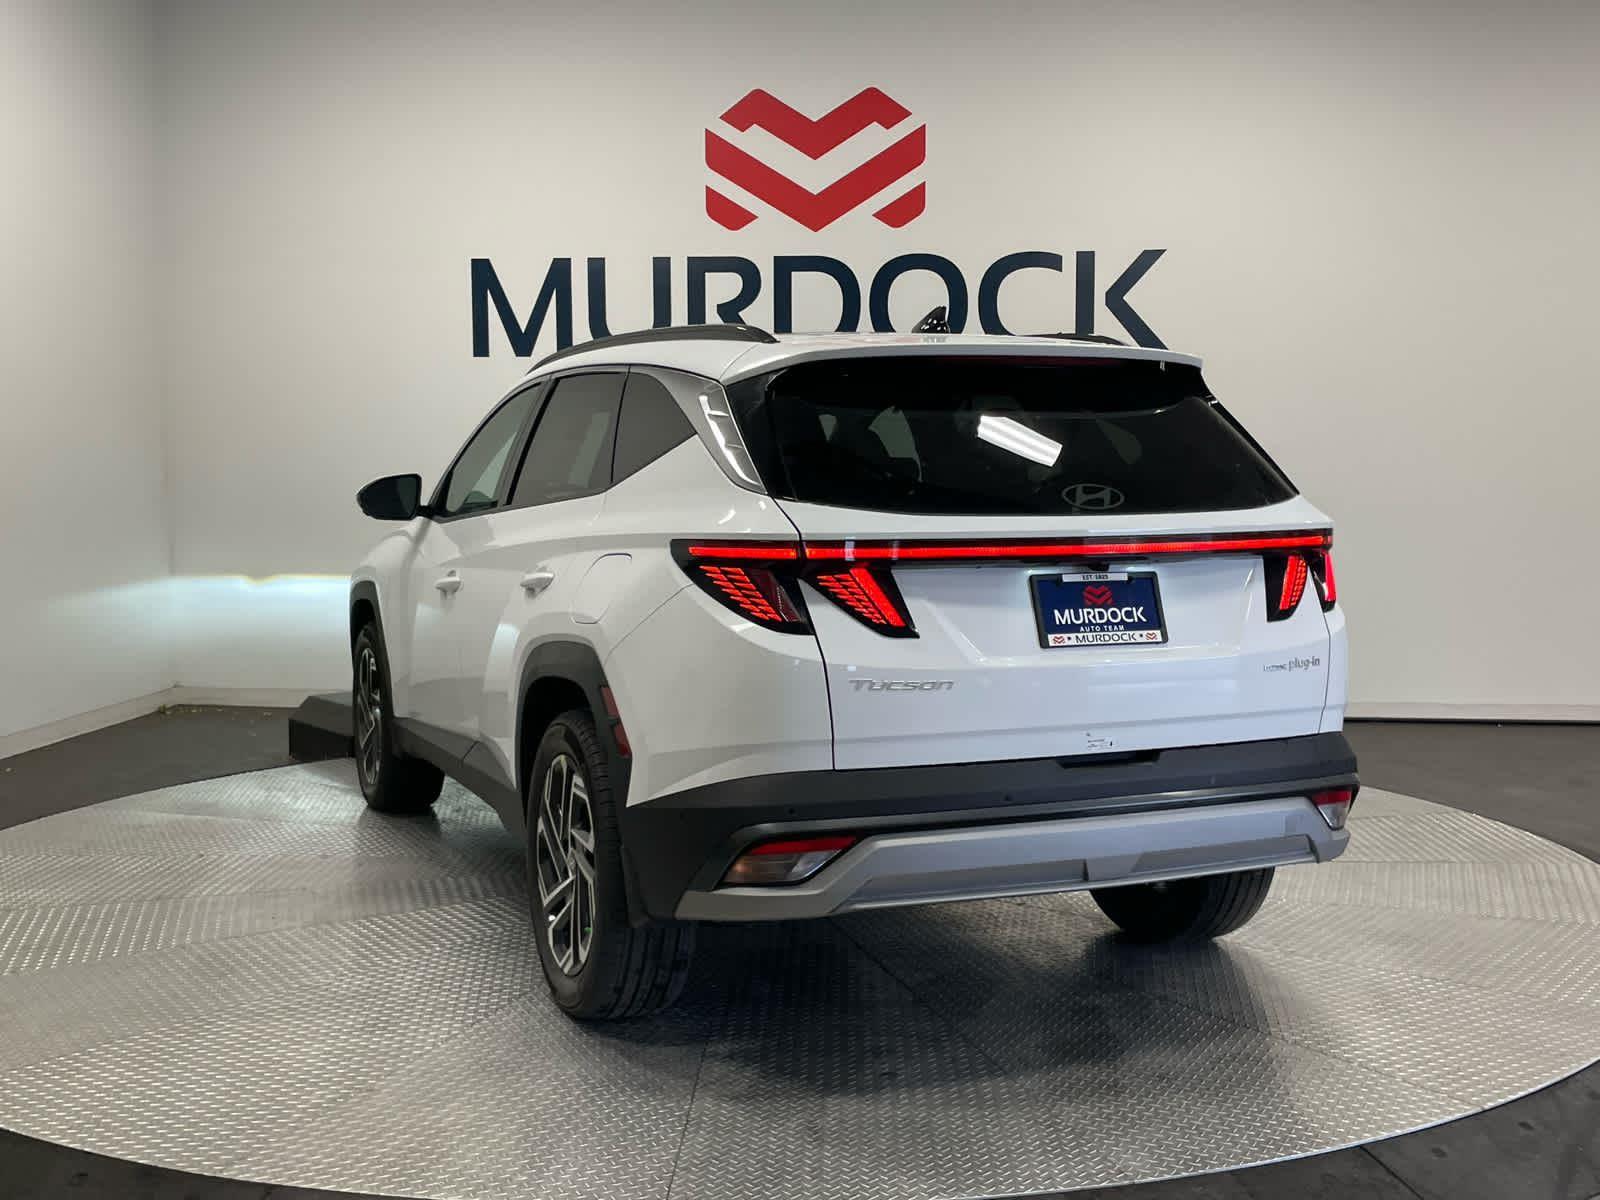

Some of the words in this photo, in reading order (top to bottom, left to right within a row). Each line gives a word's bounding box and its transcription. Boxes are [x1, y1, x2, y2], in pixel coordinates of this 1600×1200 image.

[471, 249, 1167, 358] MURDOCK
[1053, 606, 1147, 625] MURDOCK
[1075, 632, 1137, 644] MURDOCK
